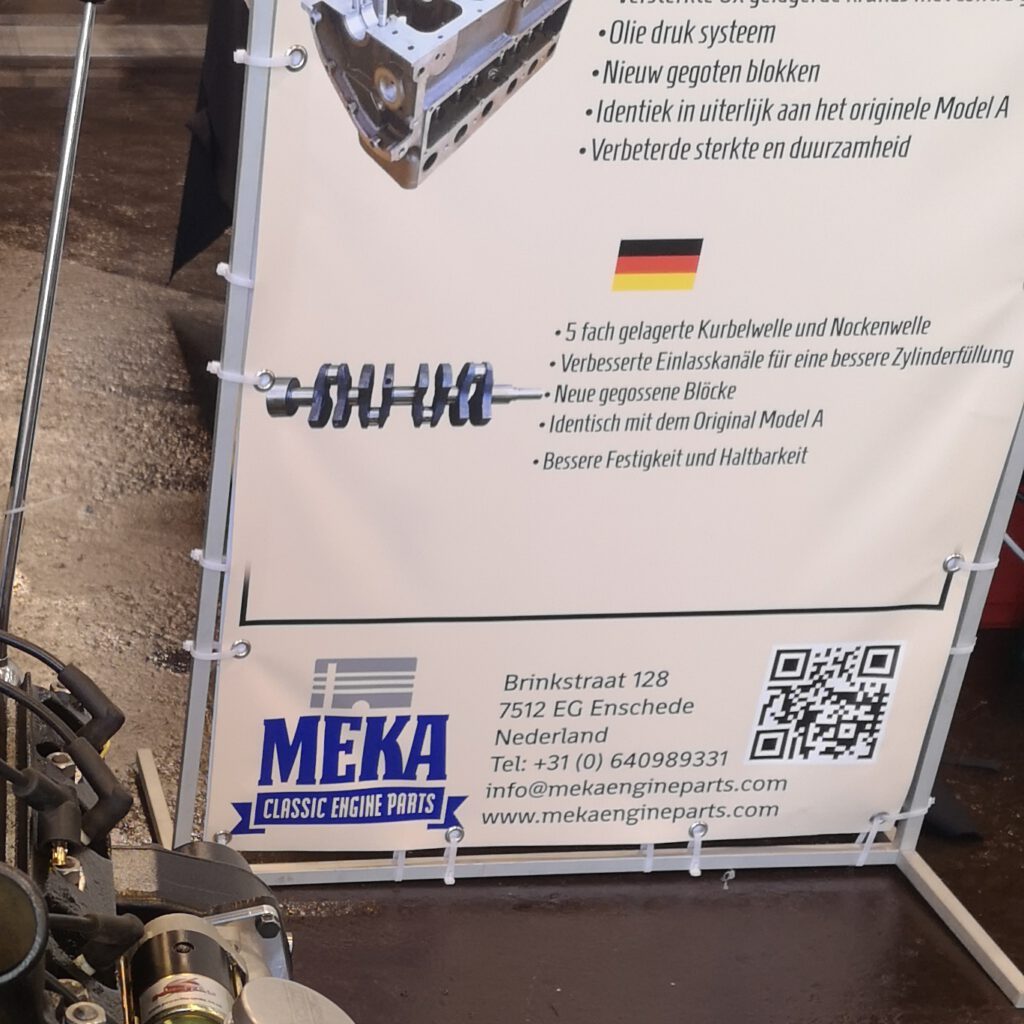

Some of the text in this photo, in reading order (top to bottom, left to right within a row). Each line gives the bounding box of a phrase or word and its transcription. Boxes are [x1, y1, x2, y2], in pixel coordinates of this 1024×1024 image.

[609, 18, 777, 50] Olie druk systeem
[602, 58, 821, 90] Nieuw gegoten blokken
[595, 94, 1010, 127] Identiek in uiterlijk aan het originele Model A
[591, 134, 913, 162] Verbeterde sterkte en duurzamheid
[564, 315, 932, 345] 5 fach gelagerte Kurbelwelle und Nockenwelle
[561, 344, 1015, 373] Verbesserte Einlasskanäle für eine bessere Zylinderfüllung
[553, 380, 737, 407] Neue gegossene Blöcke
[549, 408, 824, 434] Identisch mit dem Original Model A
[542, 446, 809, 472] Bessere Festigkeit und Haltbarkeit
[503, 670, 670, 692] Brinkstraat 128
[499, 697, 695, 720] 7512 EG Enschede
[494, 726, 609, 746] Nederland
[259, 715, 450, 786] MEKA
[490, 750, 729, 773] Tel: +31 (0) 640989331
[486, 777, 788, 799] info@mekaengineparts.com
[263, 792, 435, 820] CLASSIC ENGINE PARTS
[481, 803, 780, 825] www.mekaengineparts.com
